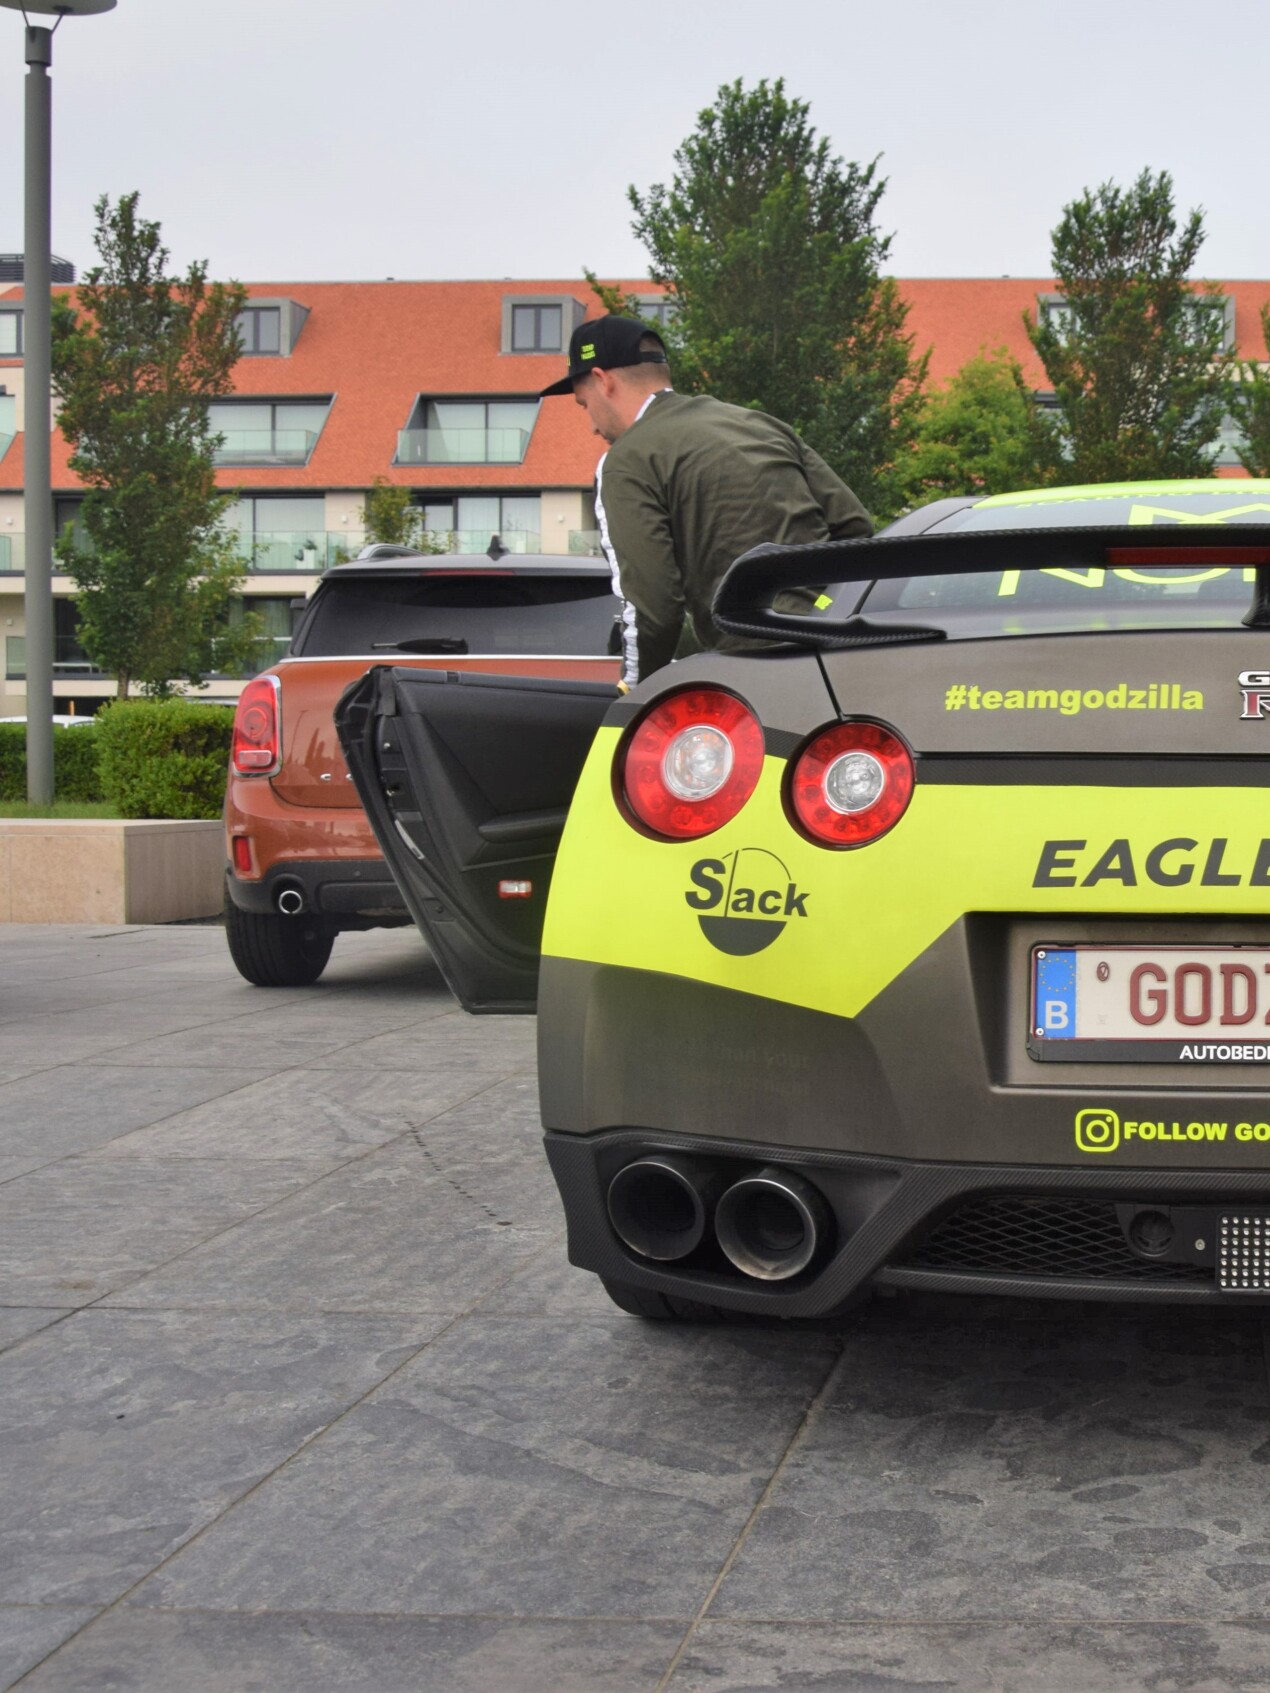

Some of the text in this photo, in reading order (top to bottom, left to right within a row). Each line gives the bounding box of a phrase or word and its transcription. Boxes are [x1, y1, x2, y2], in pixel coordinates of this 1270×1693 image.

[944, 682, 1205, 716] #teamgodzilla
[1044, 1000, 1070, 1030] B
[1123, 1121, 1228, 1141] FOLLOW
